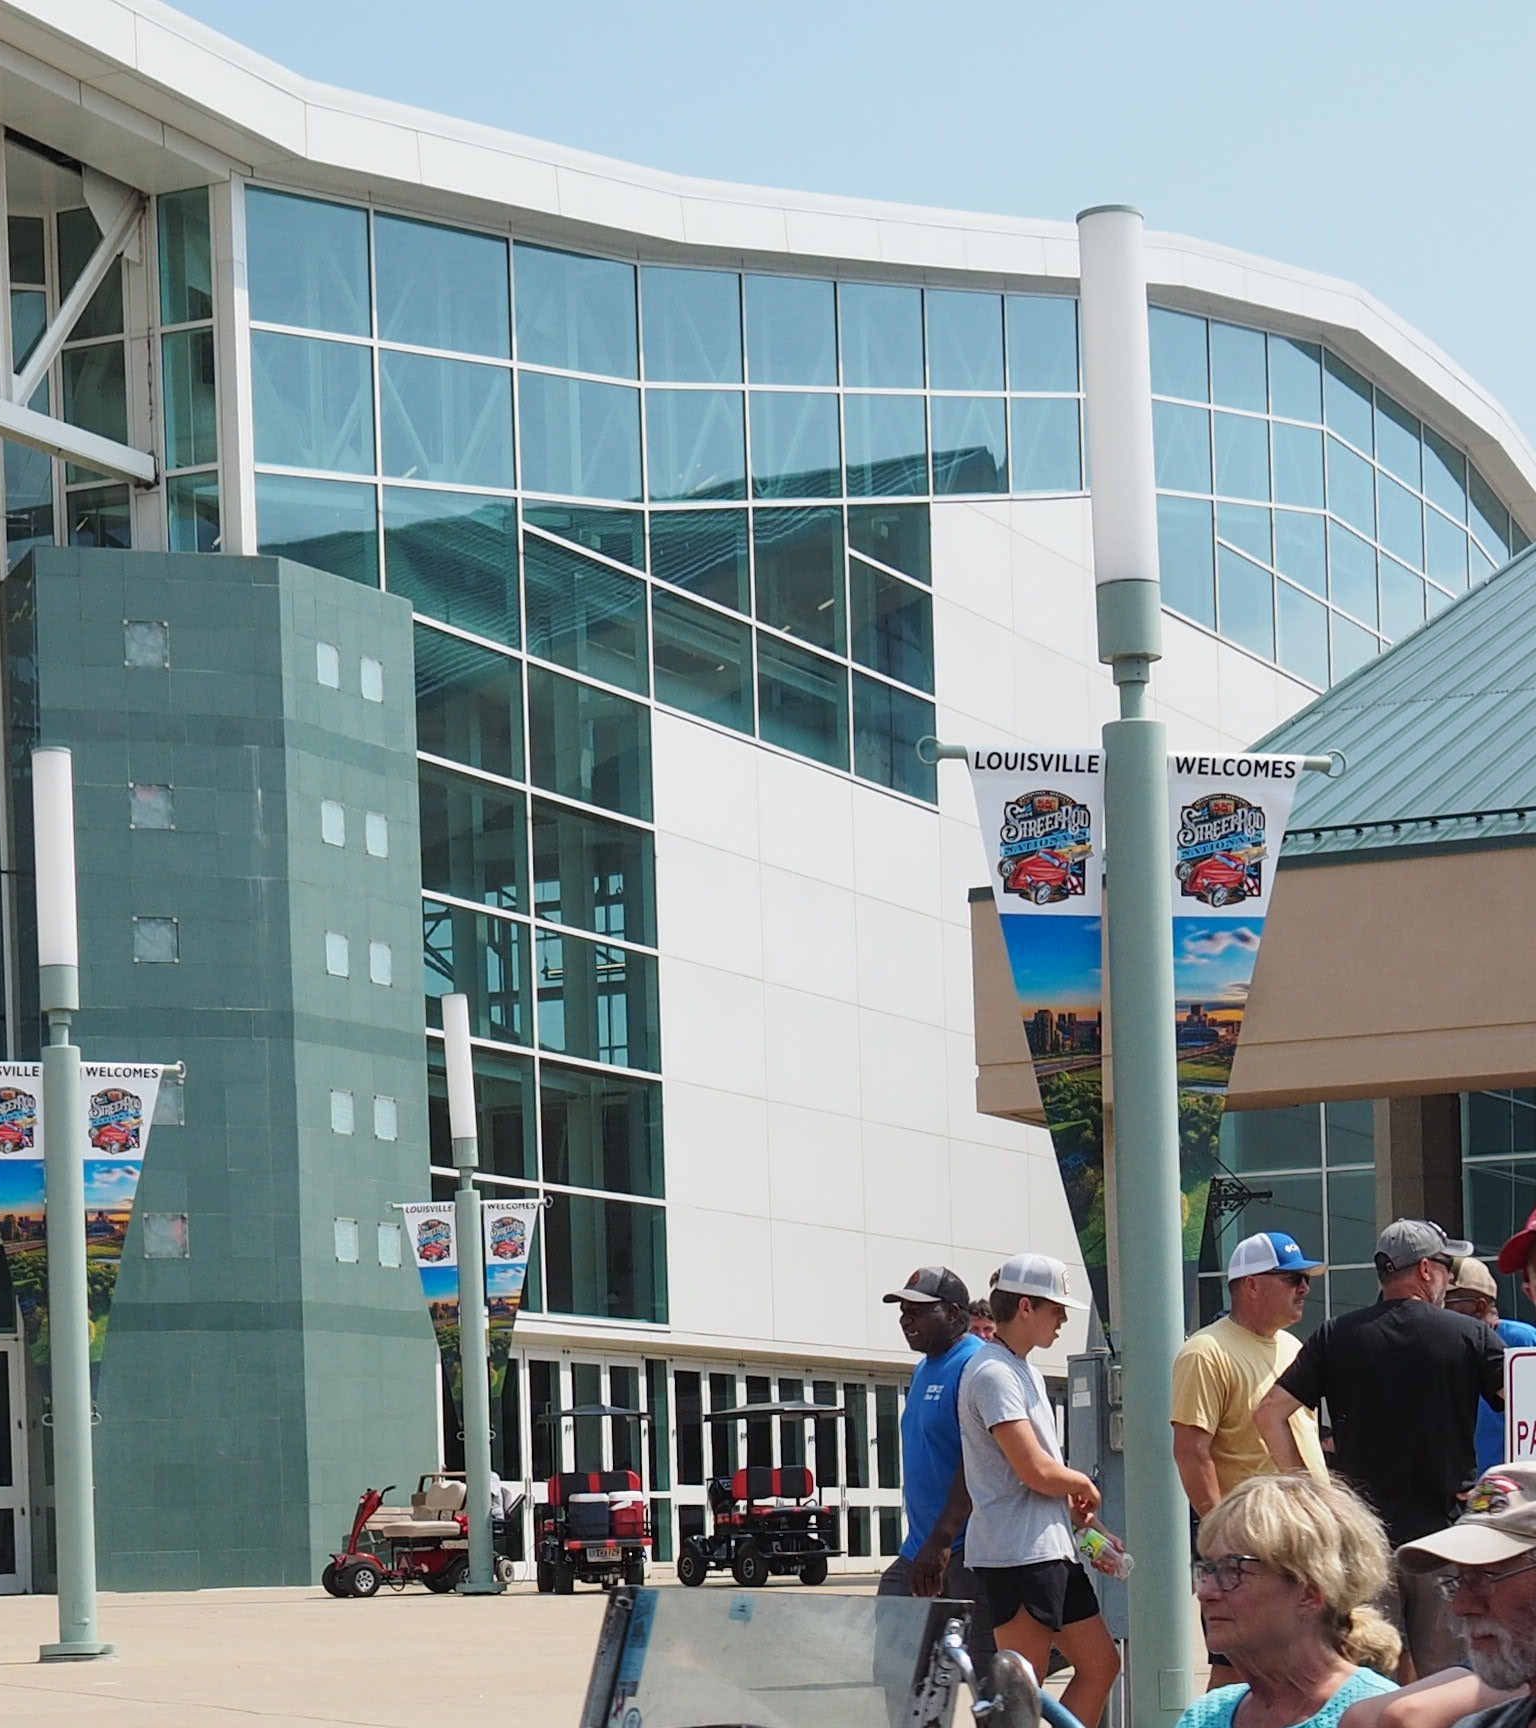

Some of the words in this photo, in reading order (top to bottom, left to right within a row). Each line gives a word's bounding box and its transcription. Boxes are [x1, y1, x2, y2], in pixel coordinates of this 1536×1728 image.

[974, 751, 1100, 773] LOUISVILLE
[1175, 756, 1296, 778] WELCOMES
[86, 1067, 159, 1079] WELCOMES
[406, 1204, 453, 1214] LOUISVILLE
[487, 1202, 536, 1210] WELCOMES
